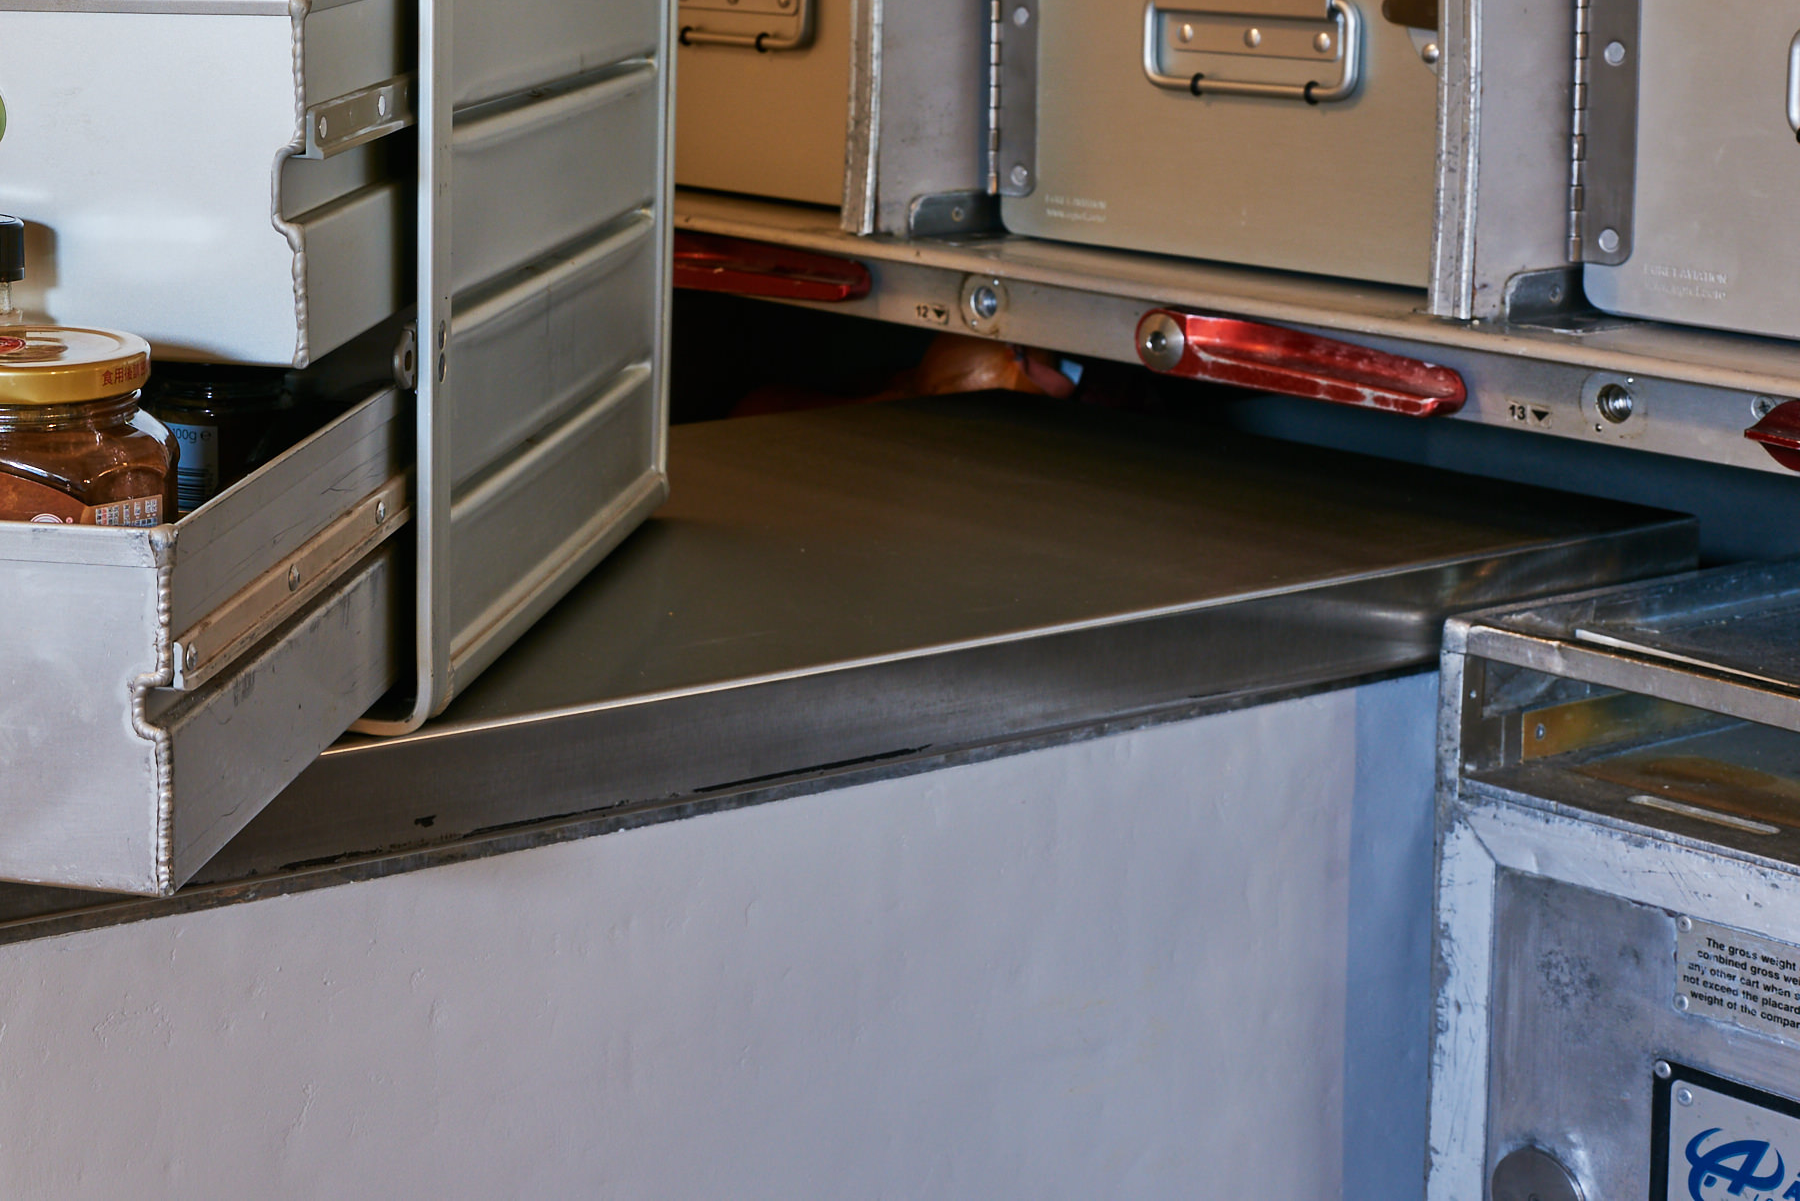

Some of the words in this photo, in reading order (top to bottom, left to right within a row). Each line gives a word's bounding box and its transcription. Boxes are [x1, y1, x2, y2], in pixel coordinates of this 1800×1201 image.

[916, 305, 928, 318] 12
[1509, 405, 1526, 420] 13
[1697, 950, 1747, 970] combined
[1750, 965, 1780, 980] gross
[1783, 974, 1800, 985] wei
[1706, 937, 1725, 951] The
[1728, 946, 1757, 959] gross
[1761, 954, 1796, 971] weight
[1683, 974, 1699, 985] not
[1702, 979, 1738, 996] exceed
[1742, 990, 1758, 1002] the
[1761, 997, 1800, 1014] placard
[1688, 962, 1707, 975] any
[1710, 968, 1736, 981] other
[1740, 978, 1759, 989] cart
[1763, 983, 1791, 997] when
[1690, 990, 1723, 1006] weight
[1726, 1001, 1737, 1010] of
[1740, 1005, 1757, 1016] the
[1760, 1011, 1800, 1029] compar
